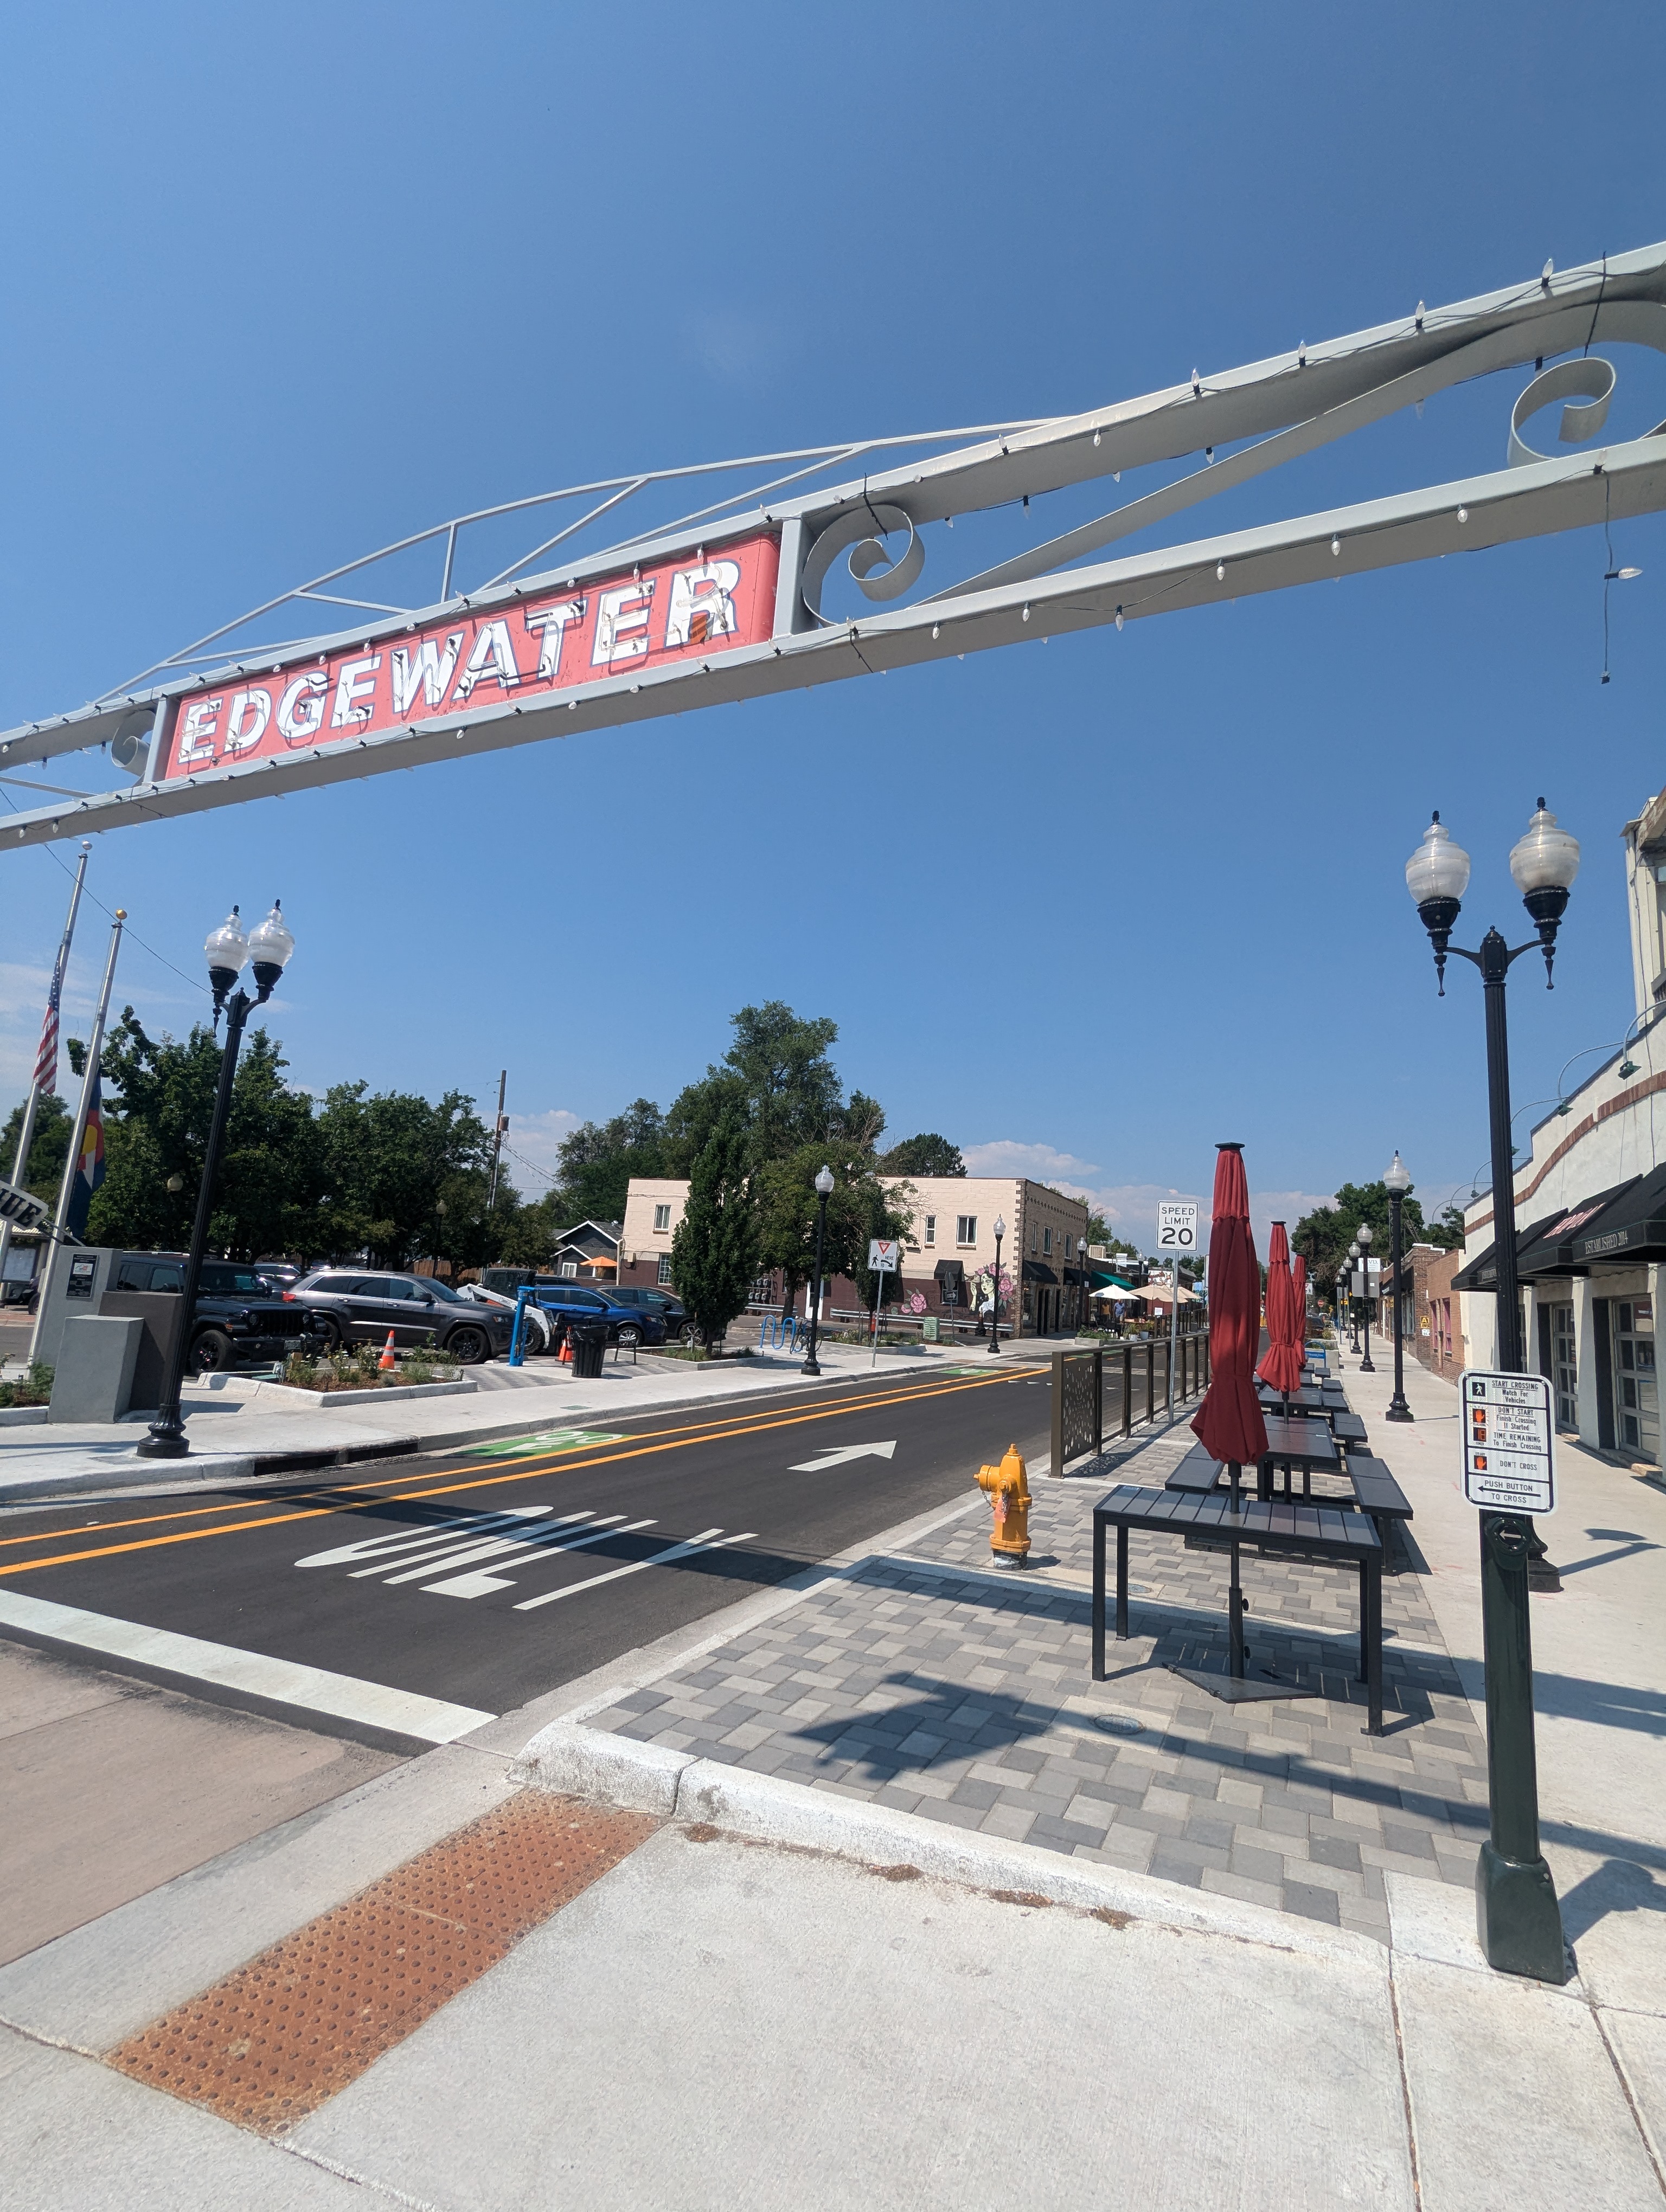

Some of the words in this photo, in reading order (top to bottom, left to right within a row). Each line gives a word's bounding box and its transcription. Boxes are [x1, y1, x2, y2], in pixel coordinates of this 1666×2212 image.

[178, 558, 741, 763] EDGEWATER
[1162, 1207, 1195, 1215] SPEED
[1164, 1217, 1190, 1225] LIMIT
[1161, 1227, 1193, 1245] 20
[1585, 1233, 1618, 1255] ESTABLISHED
[1511, 1381, 1539, 1390] CROSSING
[1505, 1396, 1526, 1404] Vehicles
[1515, 1416, 1536, 1426] Crossing
[1510, 1423, 1529, 1431] Started
[1509, 1433, 1541, 1443] REMAINING
[1520, 1442, 1542, 1452] Crossing
[1500, 1460, 1516, 1468] DON'T
[1520, 1462, 1537, 1470] CROSS
[1484, 1480, 1503, 1488] PUSH
[1506, 1482, 1533, 1491] BUTTON
[1503, 1494, 1527, 1503] CROSS
[294, 1506, 759, 1610] ONLY
